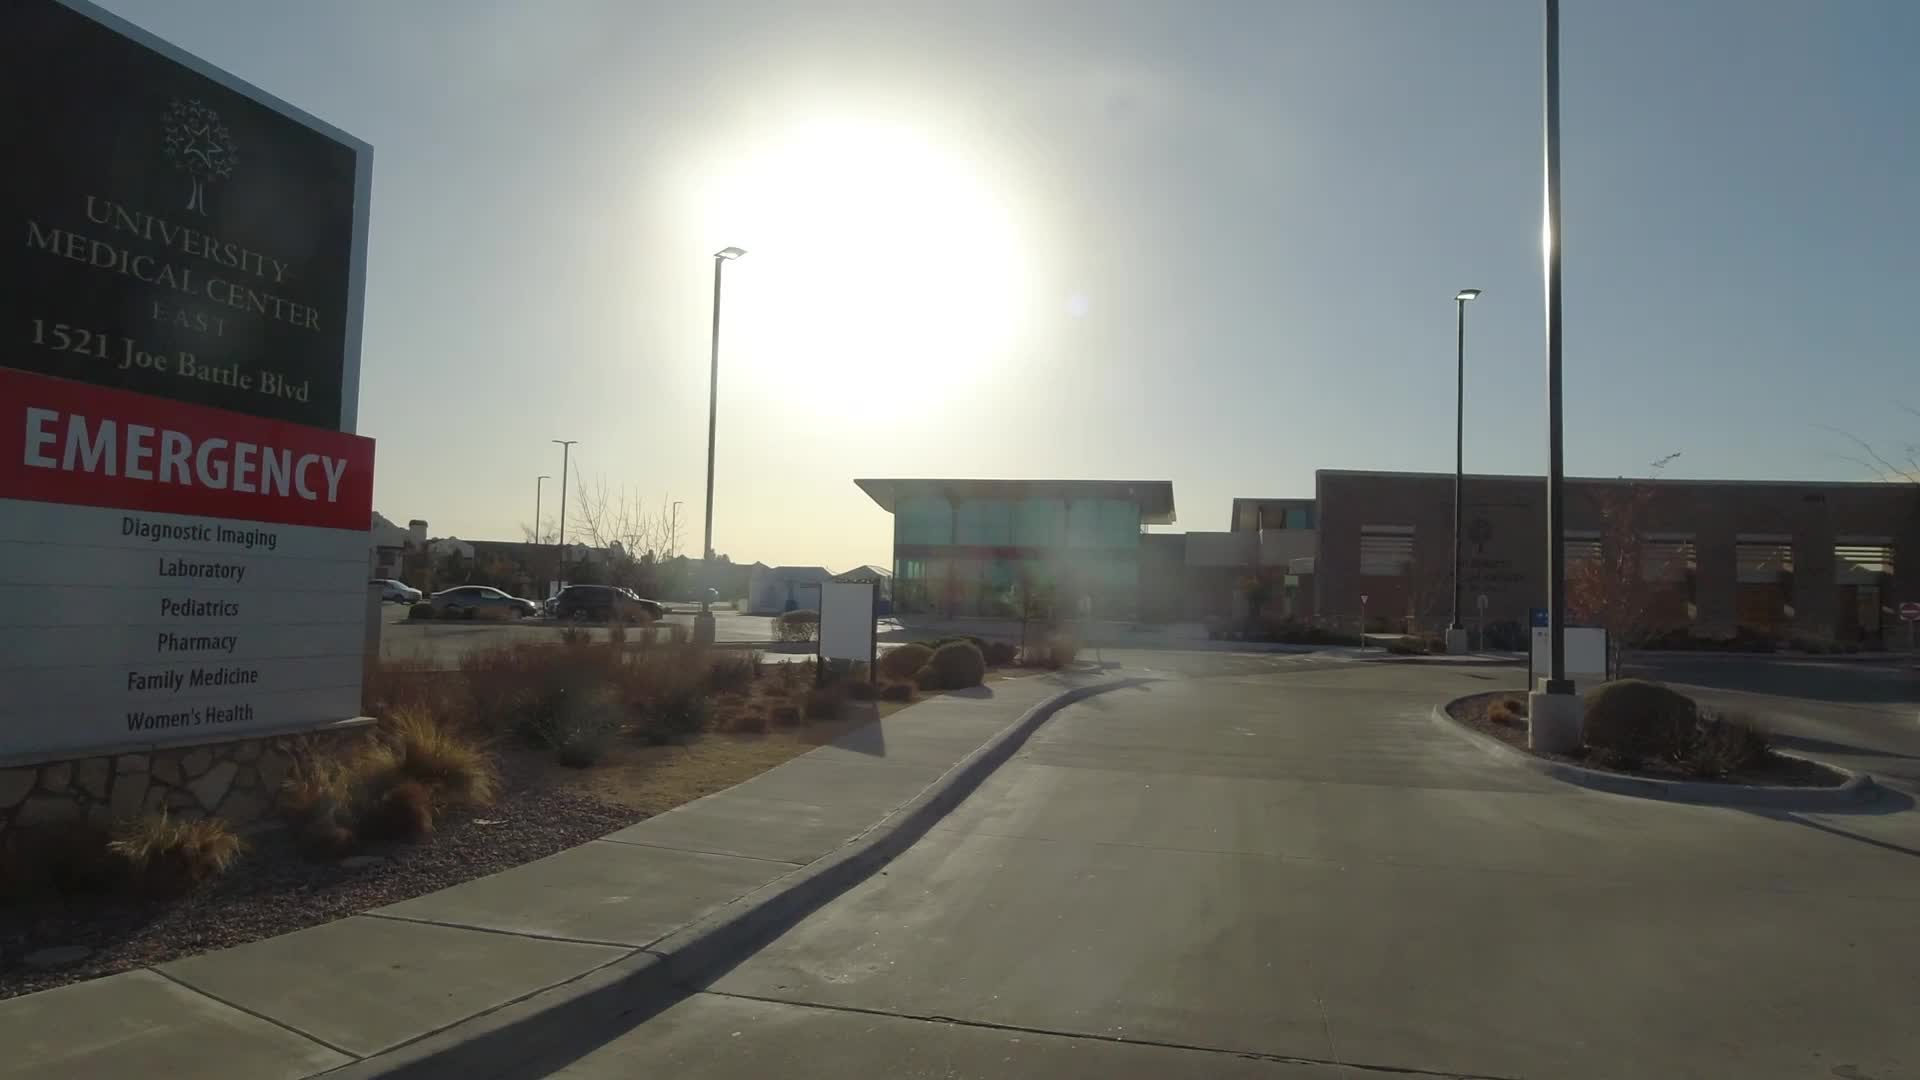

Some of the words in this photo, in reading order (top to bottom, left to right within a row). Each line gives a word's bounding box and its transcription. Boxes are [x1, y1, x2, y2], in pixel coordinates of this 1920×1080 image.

[86, 195, 288, 283] UNIVERSITY
[26, 221, 198, 295] MEDICAL
[207, 279, 321, 331] CENTER
[151, 302, 226, 337] EAST
[31, 319, 109, 358] 1521
[118, 339, 168, 372] Joe
[178, 352, 253, 390] Battle
[259, 372, 310, 403] Blvd
[24, 407, 347, 502] EMERGENCY
[121, 517, 211, 542] Diagnostic
[216, 525, 278, 550] Imaging
[159, 558, 245, 583] Laboratory
[160, 598, 239, 617] Pediatrics
[157, 633, 237, 653] Pharmacy
[127, 671, 184, 691] Family
[189, 667, 258, 687] Medicine
[127, 709, 201, 731] Women's
[205, 704, 253, 724] Health
